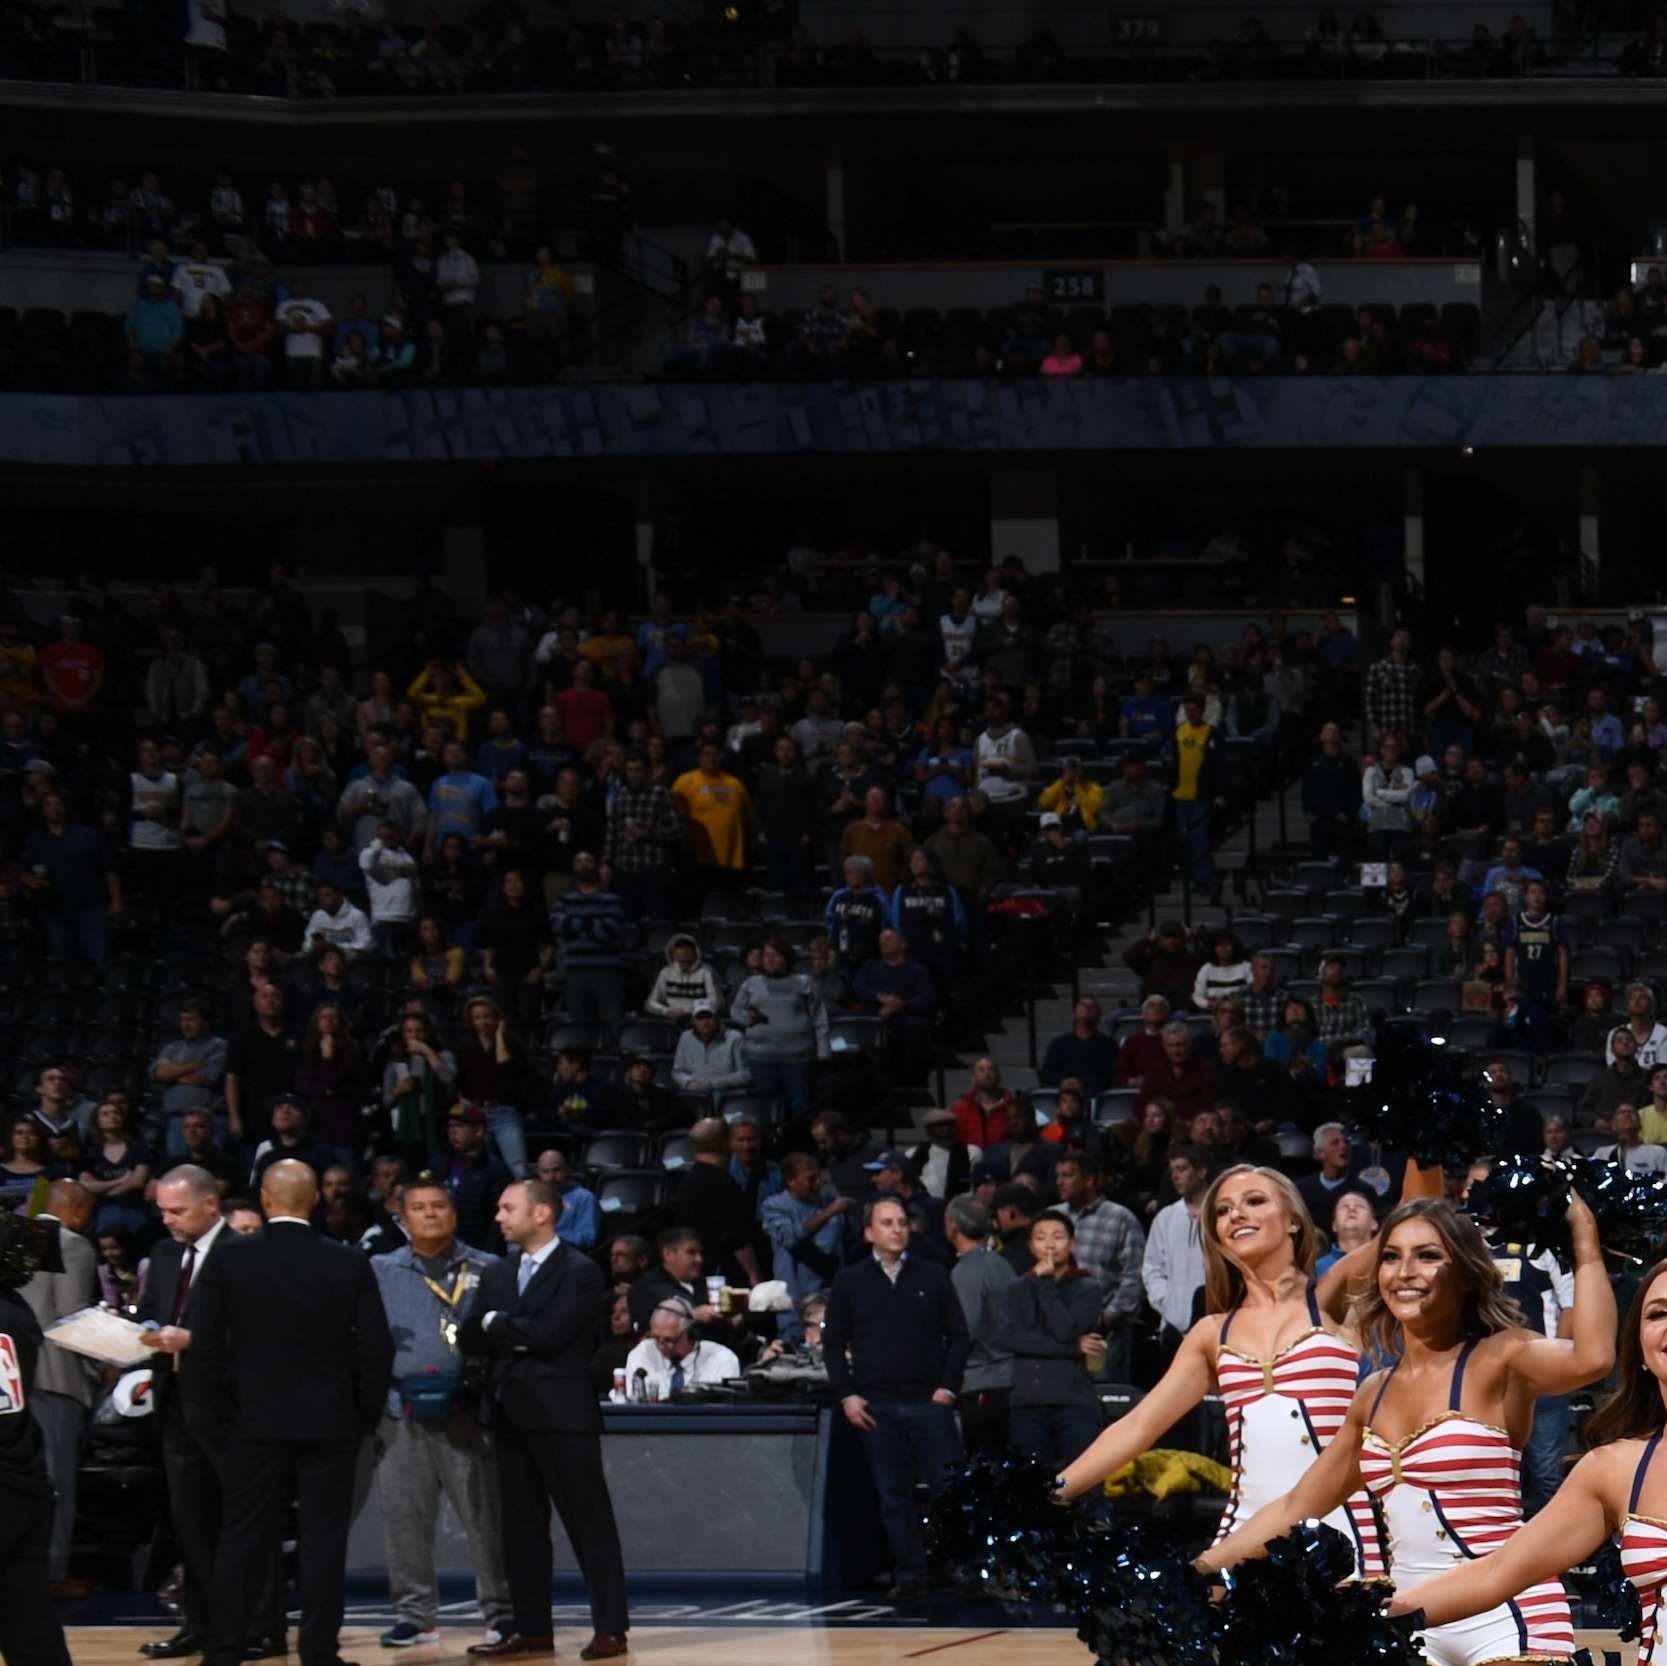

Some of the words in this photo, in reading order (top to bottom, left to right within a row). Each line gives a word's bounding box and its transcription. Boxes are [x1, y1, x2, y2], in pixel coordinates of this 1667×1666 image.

[1118, 18, 1160, 41] 379
[1052, 276, 1095, 297] 258
[1526, 944, 1543, 960] 27
